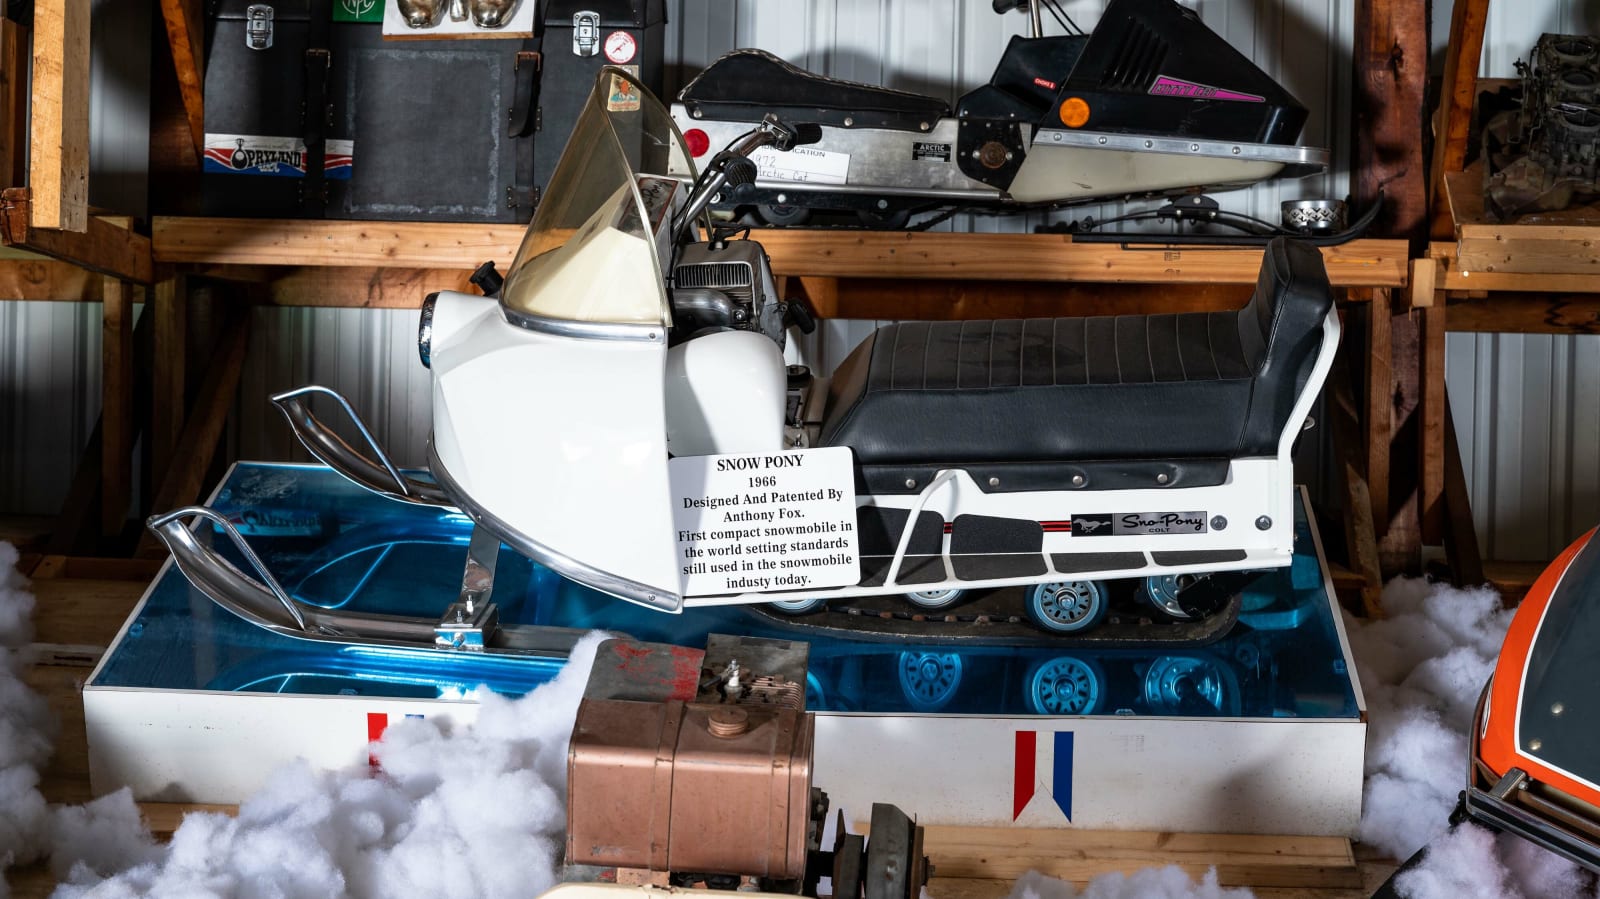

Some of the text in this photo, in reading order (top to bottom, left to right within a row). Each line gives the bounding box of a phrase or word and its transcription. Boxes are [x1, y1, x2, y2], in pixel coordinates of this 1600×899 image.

[1154, 83, 1193, 96] KITTY
[920, 144, 945, 152] ARCTIC
[717, 454, 804, 471] SNOW PONY
[749, 476, 776, 488] 1966
[683, 489, 843, 509] Designed And Patented By
[723, 508, 804, 522] Anthony Fox.
[1122, 513, 1204, 531] Sno-Pony
[678, 521, 852, 542] First compact snowmobile in
[685, 537, 848, 558] the world setting standards
[682, 553, 852, 576] still used in the snowmobile
[727, 574, 811, 589] industy today.
